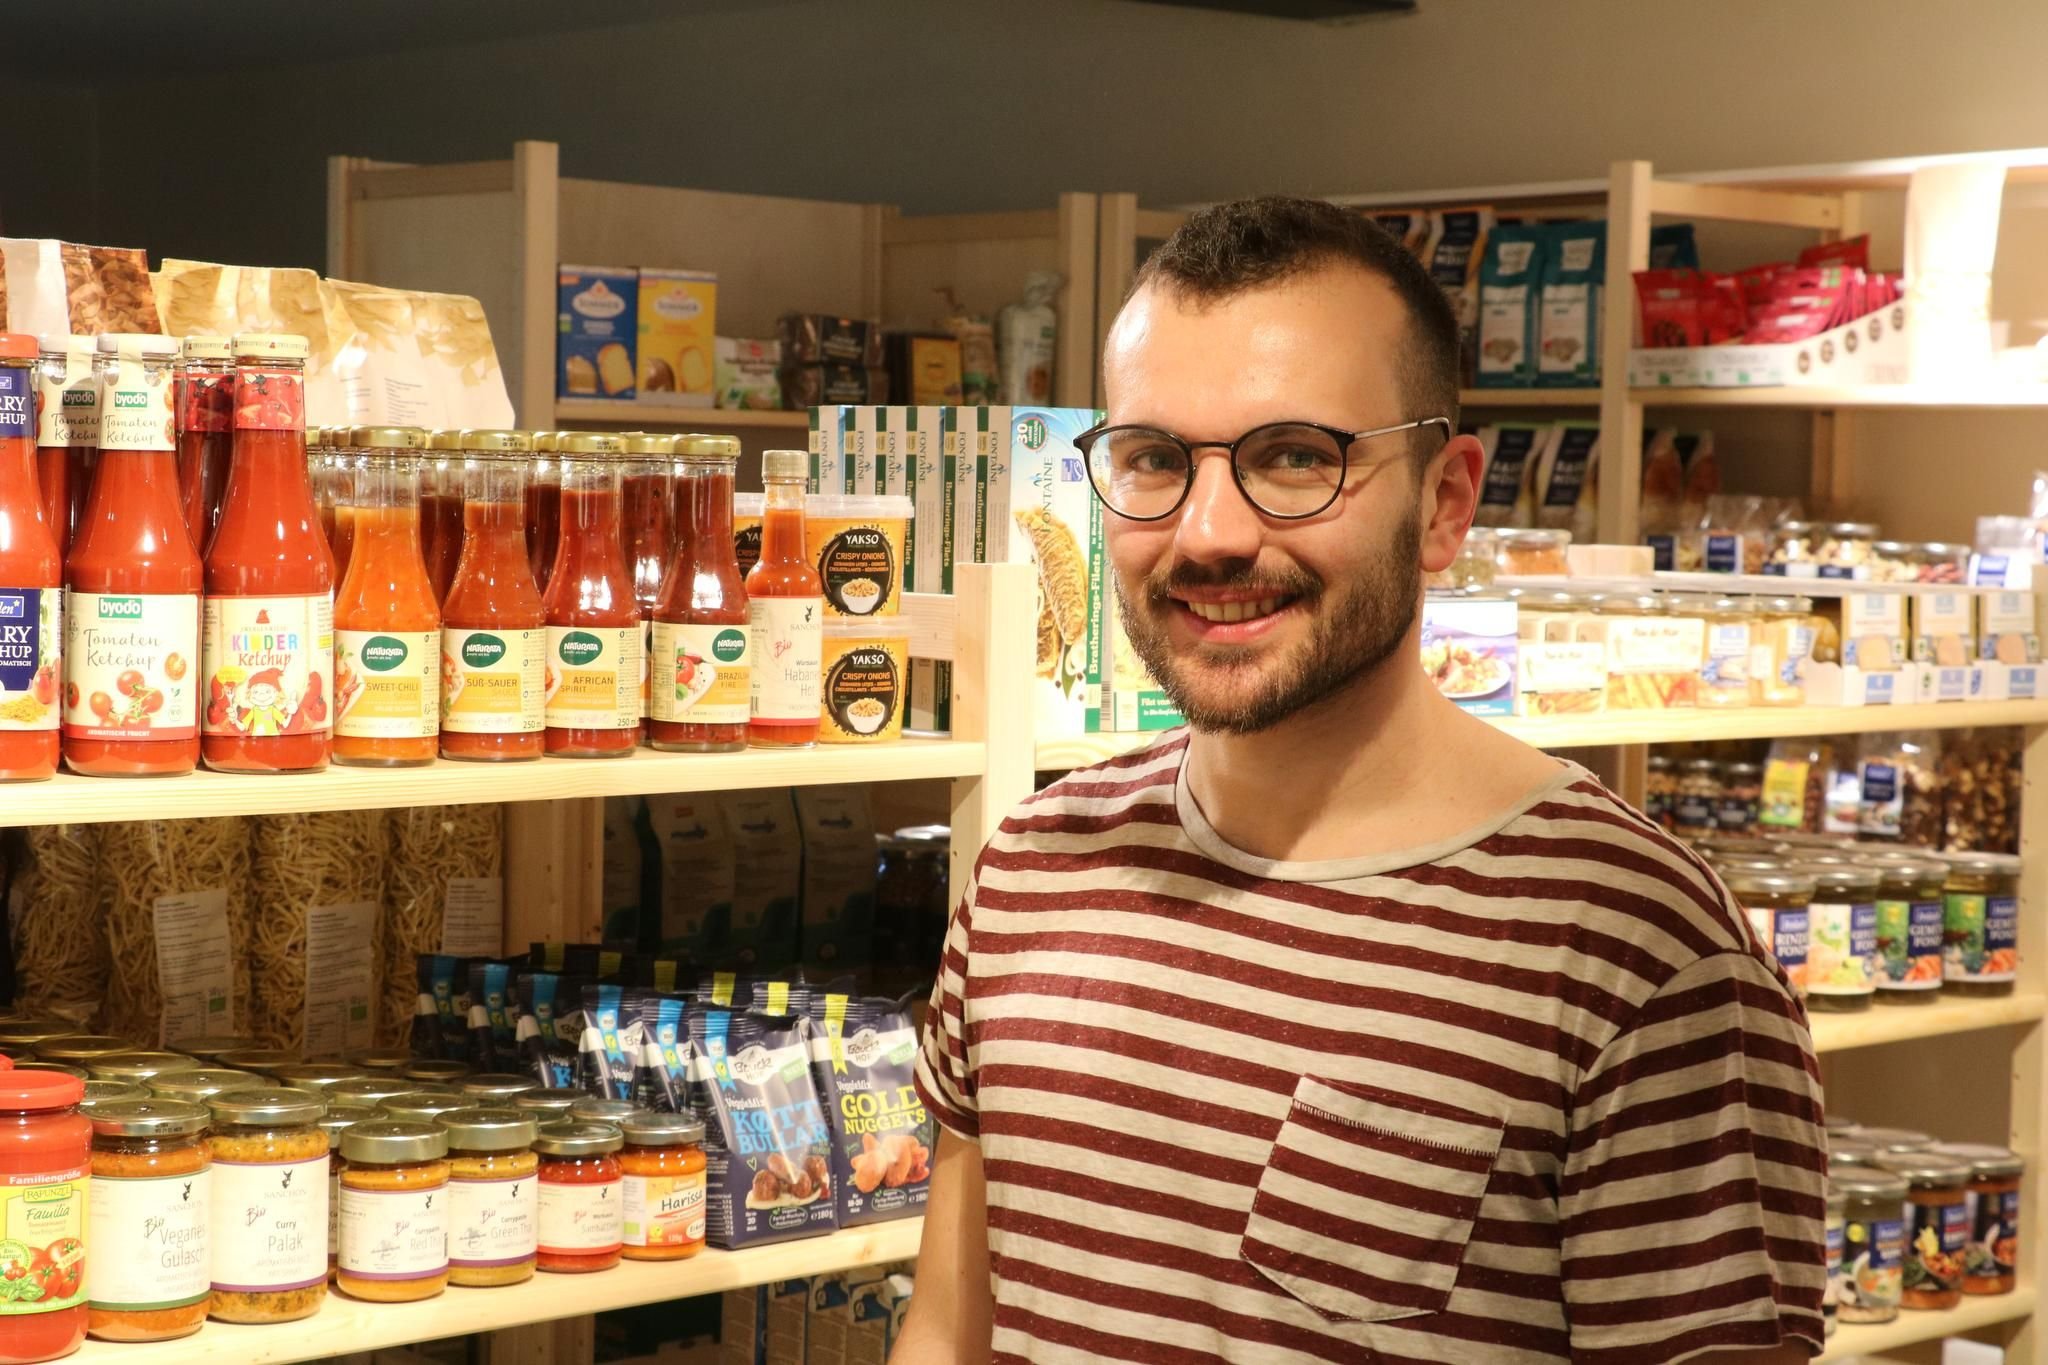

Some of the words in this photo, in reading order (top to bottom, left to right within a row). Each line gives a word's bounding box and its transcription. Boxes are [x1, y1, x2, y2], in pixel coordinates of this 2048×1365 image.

[115, 391, 148, 408] byodo
[55, 428, 98, 441] Ketchu
[1016, 422, 1029, 444] 30
[857, 430, 865, 483] FONTAINE
[888, 431, 896, 484] FONTAINE
[918, 431, 927, 484] FONTAINE
[958, 431, 966, 485] FONTAINE
[989, 431, 998, 486] FONTAINE
[1041, 454, 1054, 533] FONTAINE
[975, 481, 985, 563] Bratherings-Filet
[845, 534, 880, 545] YAKSO
[835, 552, 861, 560] CRISPY
[862, 552, 886, 560] ONIONS
[100, 598, 141, 617] byodo
[1088, 553, 1102, 675] Bratherings-Filets
[83, 628, 160, 648] Tomaten
[231, 633, 298, 652] KINDER
[563, 642, 599, 652] NATURATA
[366, 646, 404, 657] NATURATA
[466, 644, 502, 654] NATURATA
[86, 648, 157, 671] Ketchup
[238, 648, 292, 673] Ketchup
[851, 654, 885, 665] YAKSO
[572, 676, 614, 686] AFRICAN
[841, 672, 866, 681] CRISPY
[867, 671, 891, 680] ONIONS
[366, 682, 419, 692] SWEET-CHILI
[560, 685, 587, 693] SPIRIT
[840, 1084, 923, 1119] GOLD
[843, 1107, 928, 1136] NUGGETS
[9, 1170, 82, 1185] Familiengröße
[661, 1188, 704, 1212] Harissa
[26, 1203, 70, 1221] Familia
[275, 1220, 297, 1230] Curry
[490, 1225, 519, 1240] Green
[267, 1231, 304, 1254] Palak
